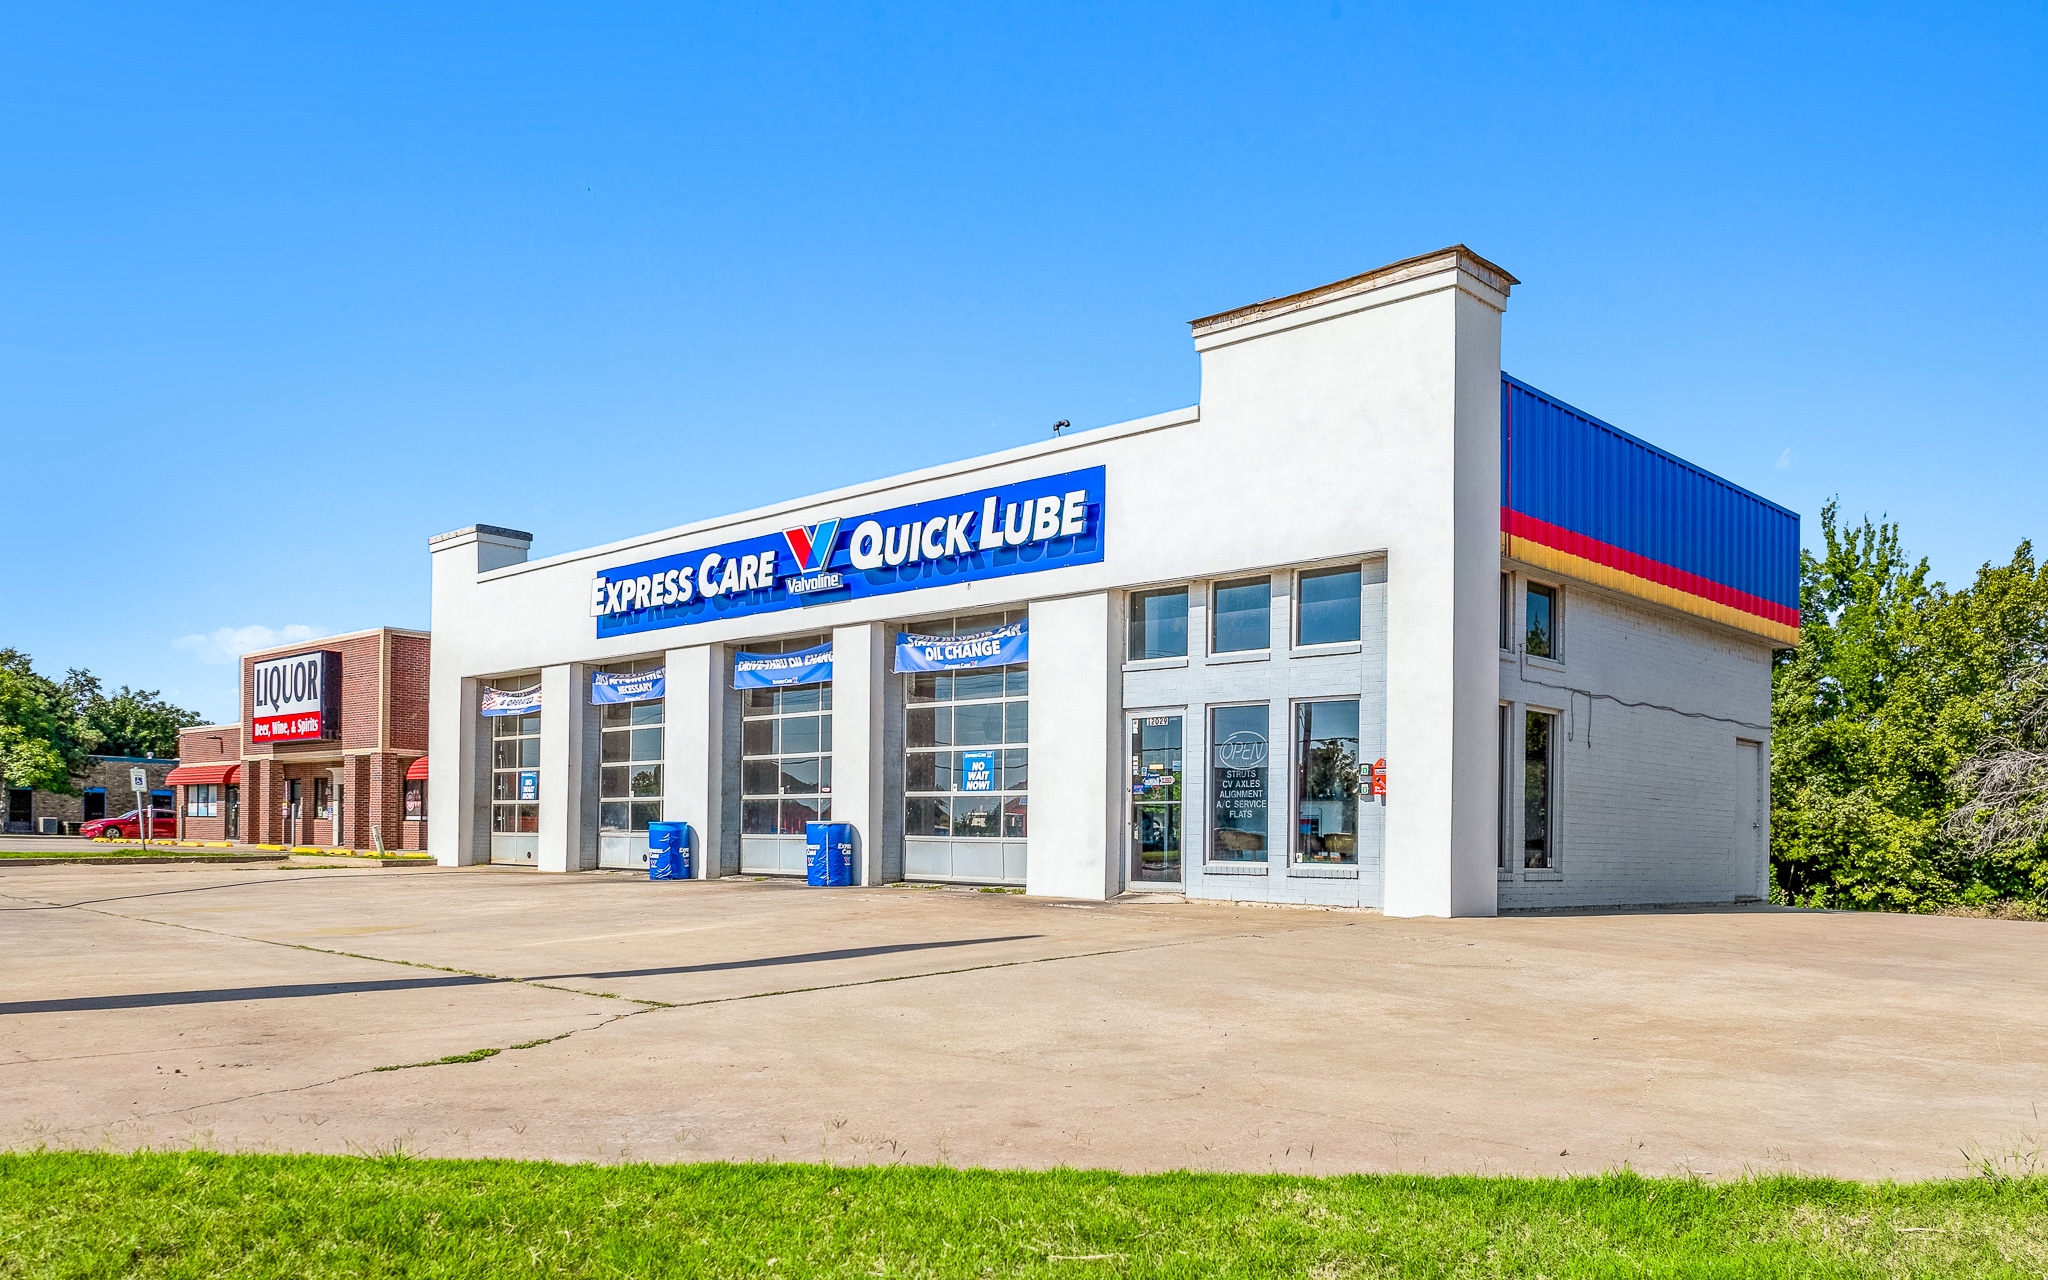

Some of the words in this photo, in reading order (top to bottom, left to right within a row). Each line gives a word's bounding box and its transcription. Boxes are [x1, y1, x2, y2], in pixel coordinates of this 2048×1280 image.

[850, 511, 976, 570] QUICK
[979, 489, 1087, 550] LUBE
[590, 566, 694, 617] EXPRESS
[699, 551, 776, 598] CARE
[788, 574, 840, 594] Valvoline
[925, 647, 944, 661] OIL
[945, 640, 1001, 660] CHANGE
[737, 657, 789, 672] DRIVE-THRU
[789, 656, 804, 668] OIL
[256, 660, 319, 712] LIQUOR
[617, 682, 653, 695] NECESSARY
[1147, 716, 1168, 726] 12029
[254, 723, 271, 738] Beer,
[271, 720, 290, 736] Wine,
[290, 720, 297, 734] &
[297, 717, 319, 736] Spirits
[1222, 741, 1264, 760] OPEN
[971, 761, 985, 771] NO
[967, 771, 990, 780] WAIT
[1226, 770, 1257, 778] STRUTS
[966, 780, 990, 790] NOW!
[1235, 780, 1261, 788] AXLES
[1220, 790, 1264, 798] ALIGNMENT
[1216, 800, 1231, 808] A/C
[1234, 800, 1266, 808] SERVICE
[1229, 810, 1253, 818] FLATS
